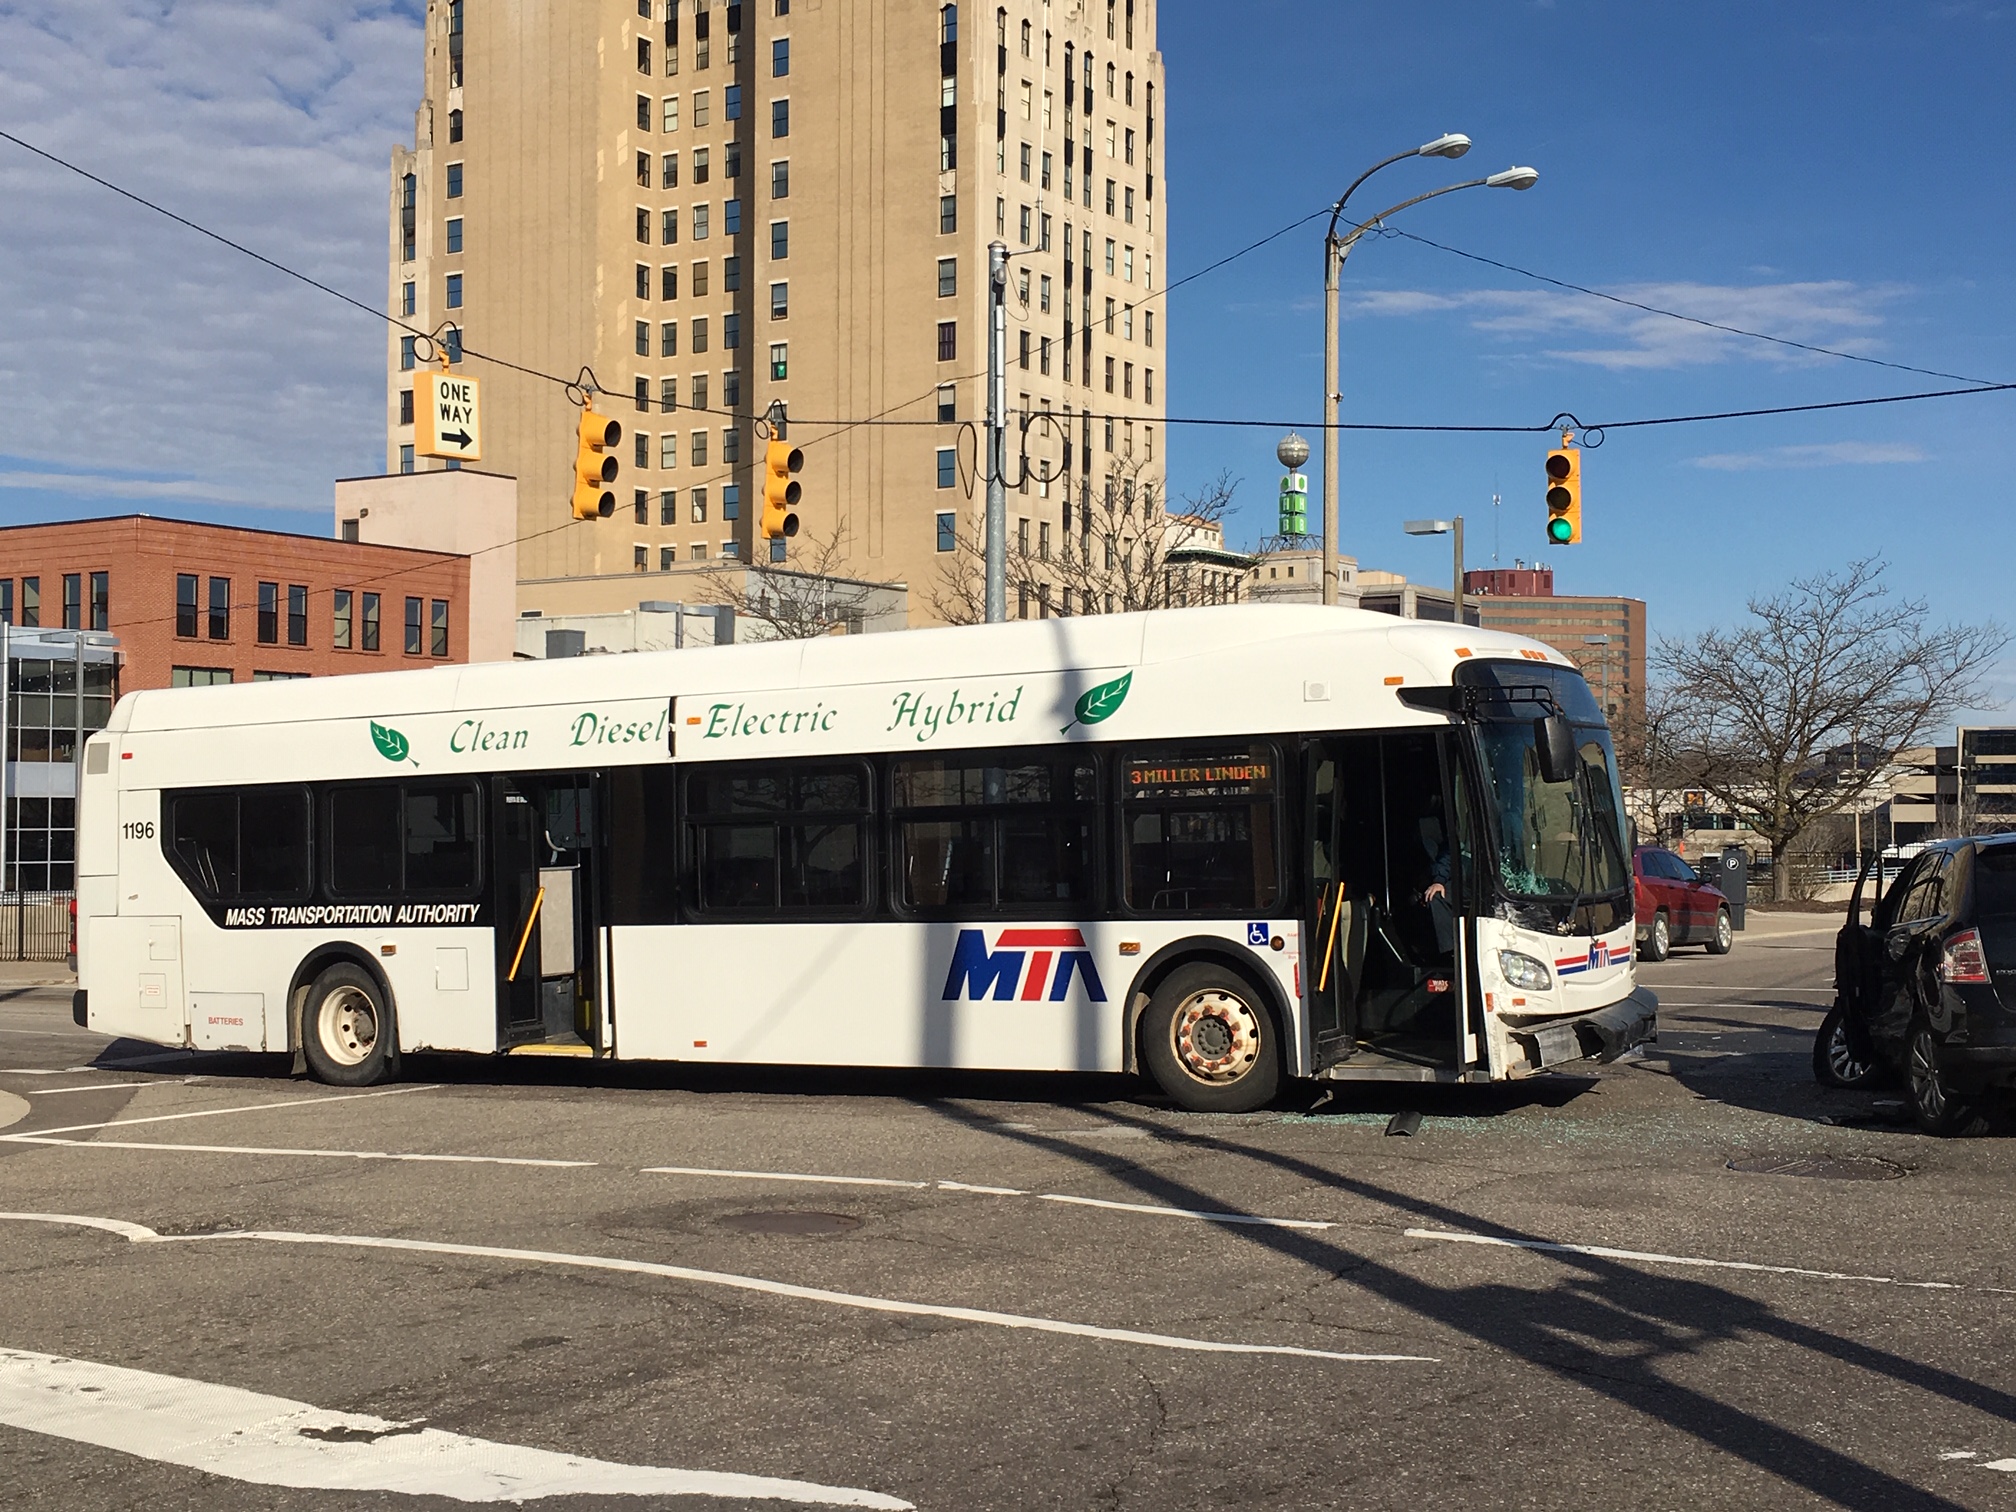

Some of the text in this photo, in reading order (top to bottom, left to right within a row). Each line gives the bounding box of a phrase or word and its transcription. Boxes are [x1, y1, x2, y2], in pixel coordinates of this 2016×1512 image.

[440, 381, 471, 403] ONE
[440, 402, 472, 424] WAY
[450, 684, 1024, 753] Clean Diesel Electric Hybrid
[1131, 764, 1266, 784] 3 MILLER LINDEN
[122, 821, 155, 840] 1196
[225, 903, 481, 926] MASS TRANSPORTATION AUTHORITY
[941, 928, 1108, 1002] MTA
[1588, 941, 1611, 970] MTA
[208, 1016, 244, 1026] BATTERIES
